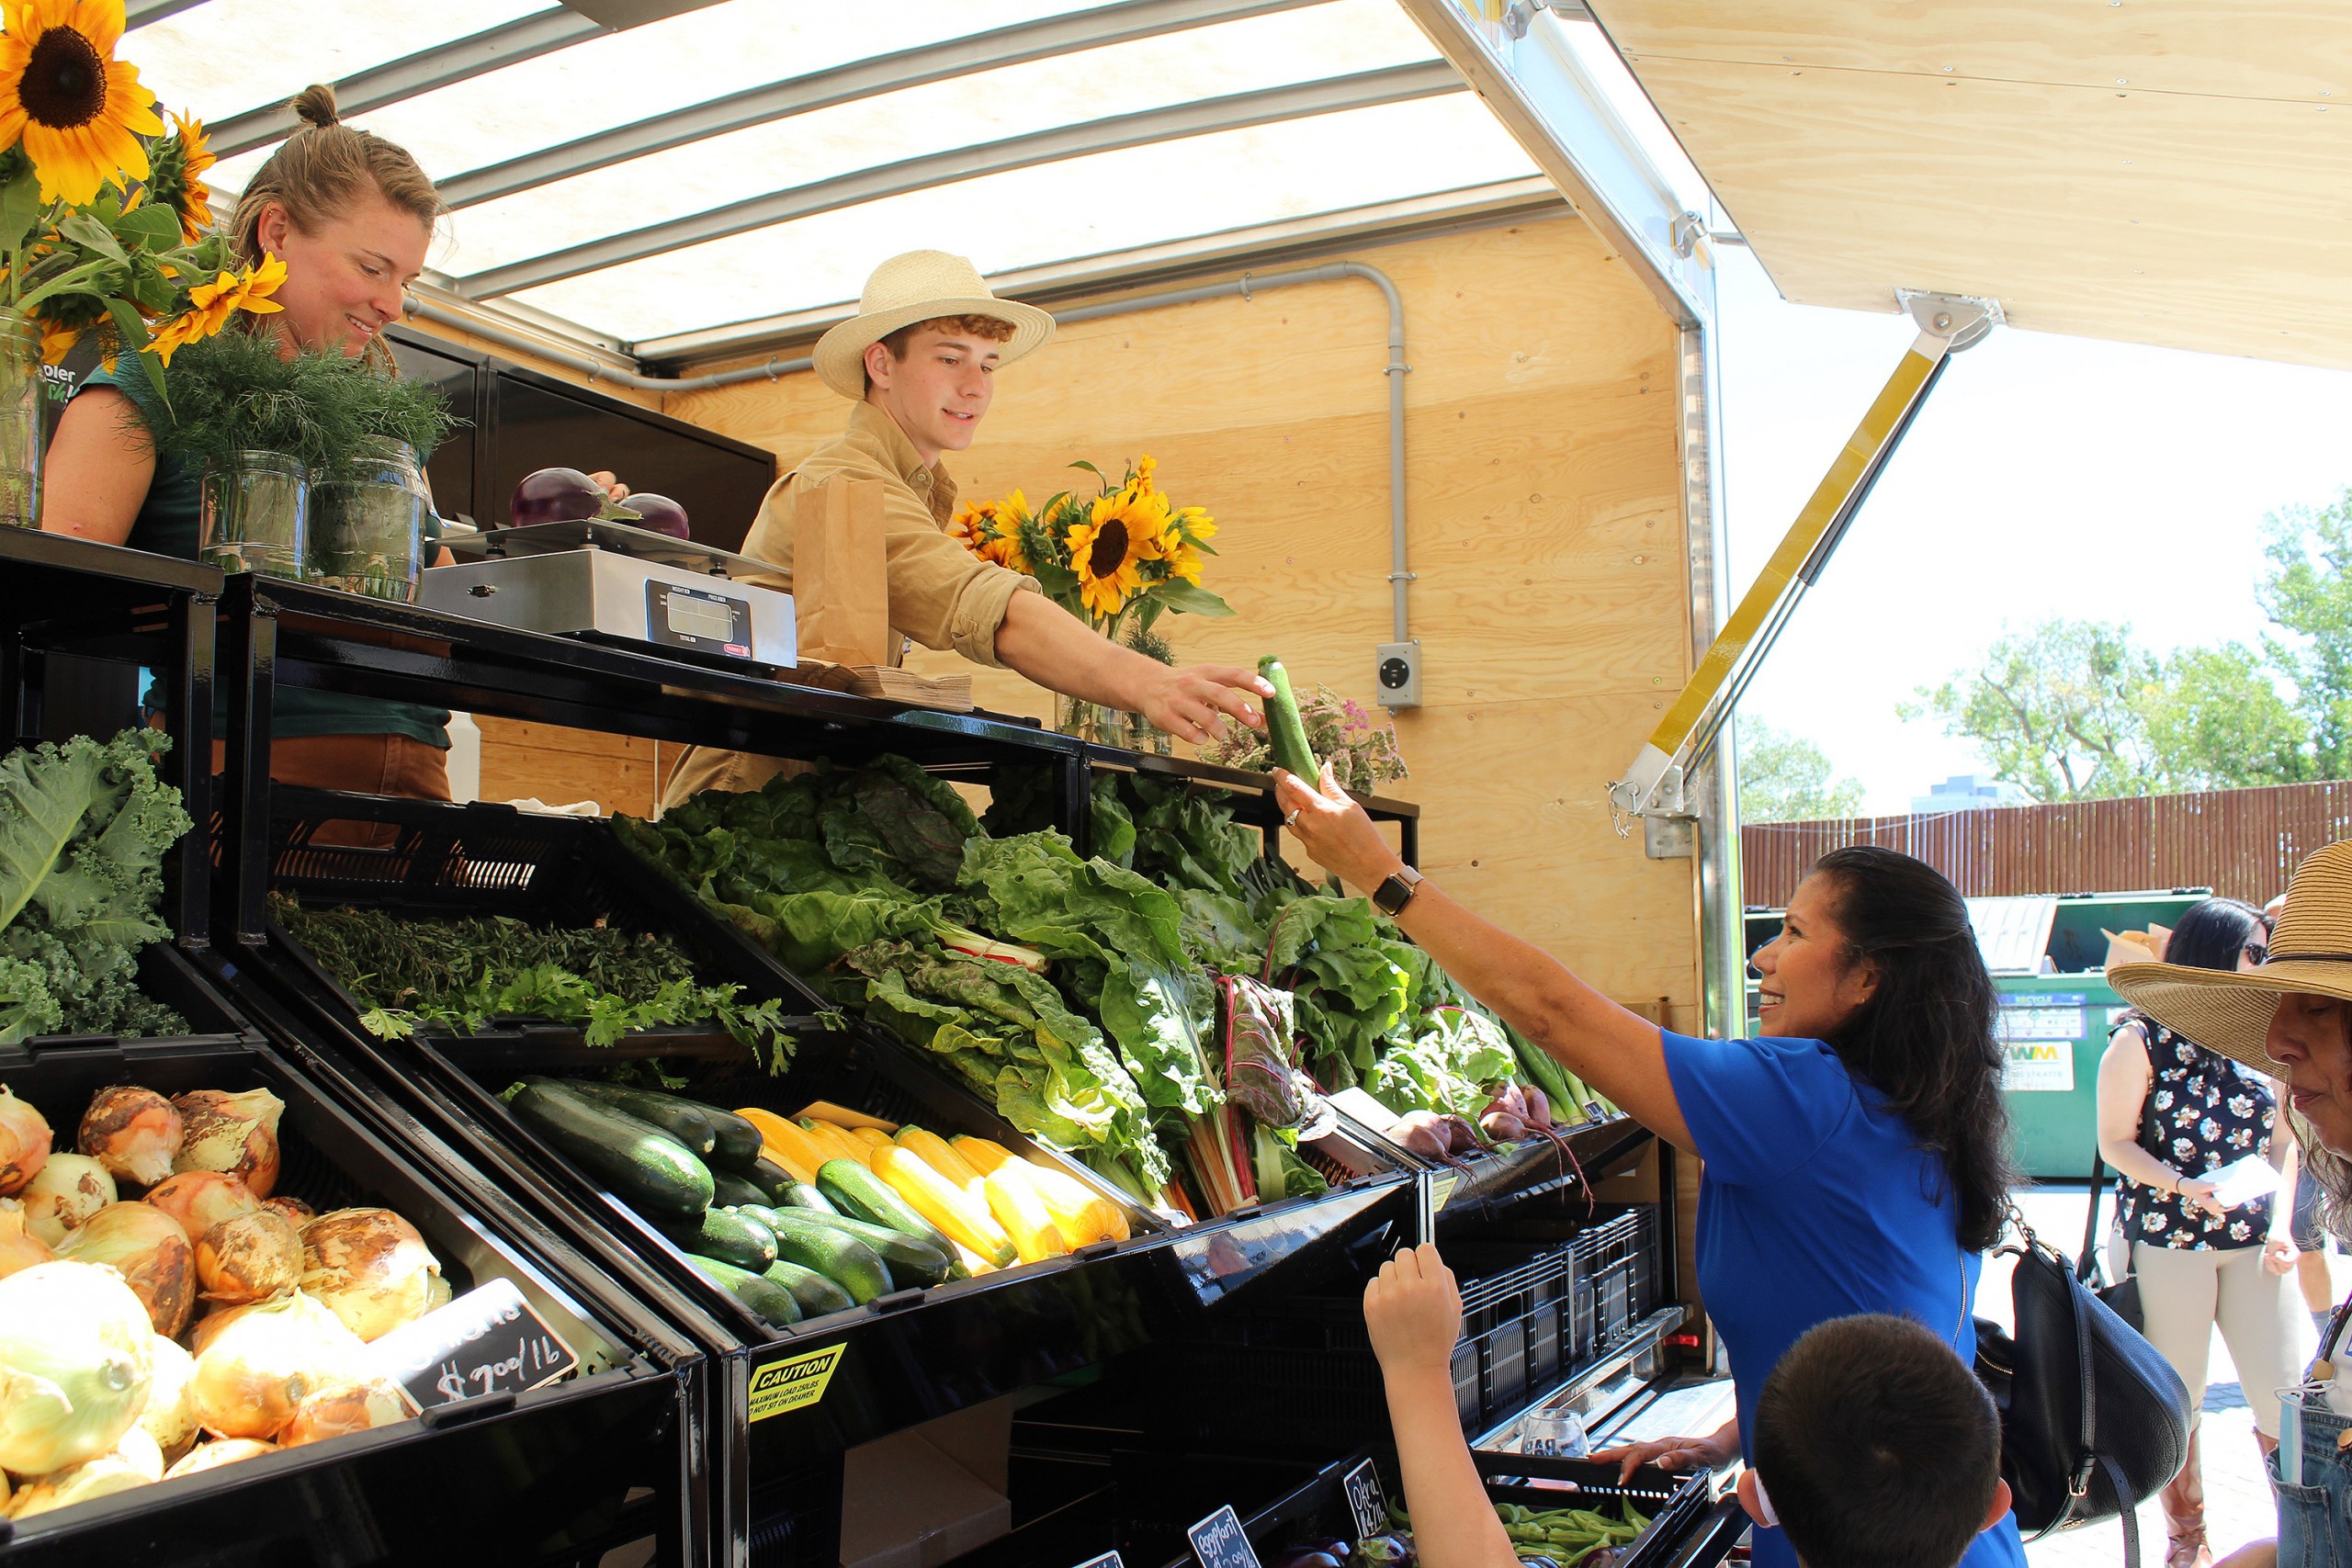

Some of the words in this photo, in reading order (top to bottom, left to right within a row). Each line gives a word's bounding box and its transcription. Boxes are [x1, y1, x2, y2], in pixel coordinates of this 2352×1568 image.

[43, 364, 76, 383] oler
[48, 382, 74, 404] sh!
[2009, 1045, 2058, 1060] WM
[759, 1356, 831, 1390] CAUTION
[749, 1392, 780, 1404] MAXIMUM
[779, 1387, 797, 1396] LOAD
[753, 1404, 768, 1414] NOT
[767, 1401, 779, 1410] SIT
[778, 1398, 789, 1406] ON
